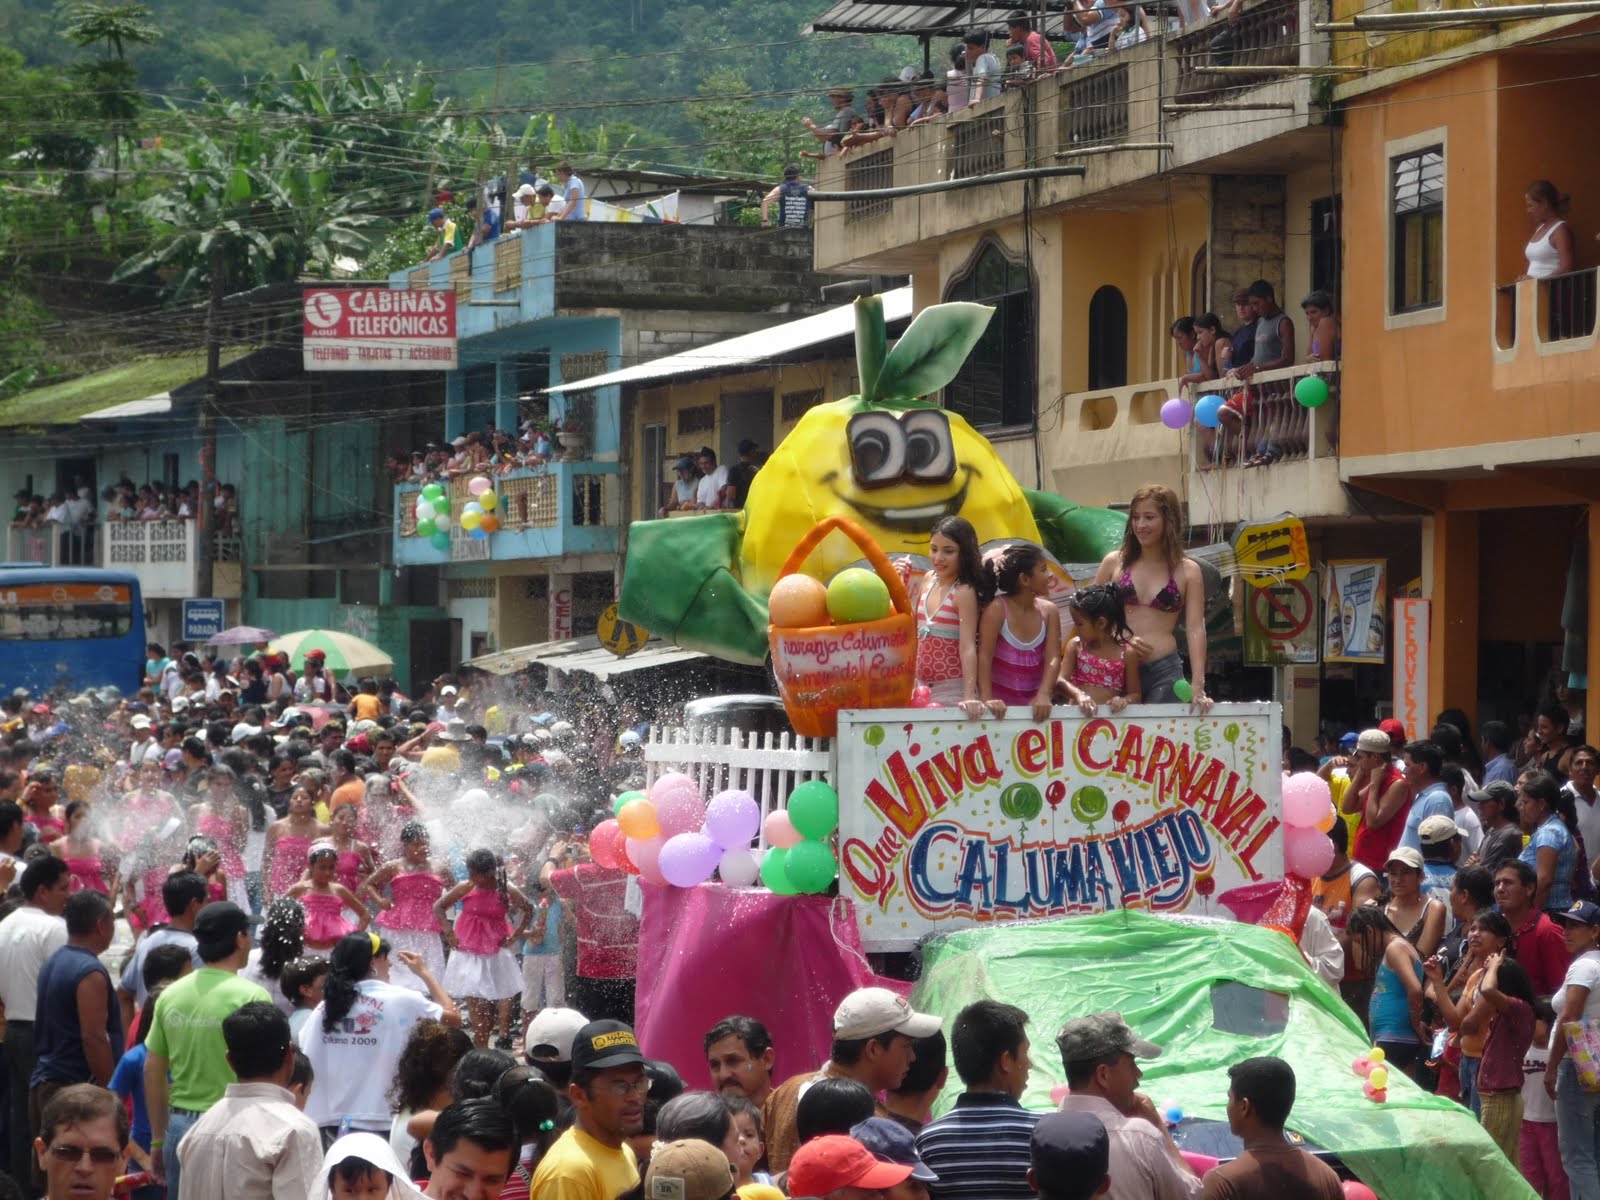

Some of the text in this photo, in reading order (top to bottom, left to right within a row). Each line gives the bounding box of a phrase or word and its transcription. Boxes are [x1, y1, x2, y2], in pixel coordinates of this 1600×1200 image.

[348, 291, 447, 313] CABINAS
[347, 314, 448, 336] TELEFÓNICAS
[188, 625, 218, 635] PARADA
[783, 640, 840, 664] naranja
[1404, 601, 1419, 741] CERVEZA
[842, 718, 1281, 908] Que Viva el CARNAVAL
[351, 1037, 377, 1046] 2009
